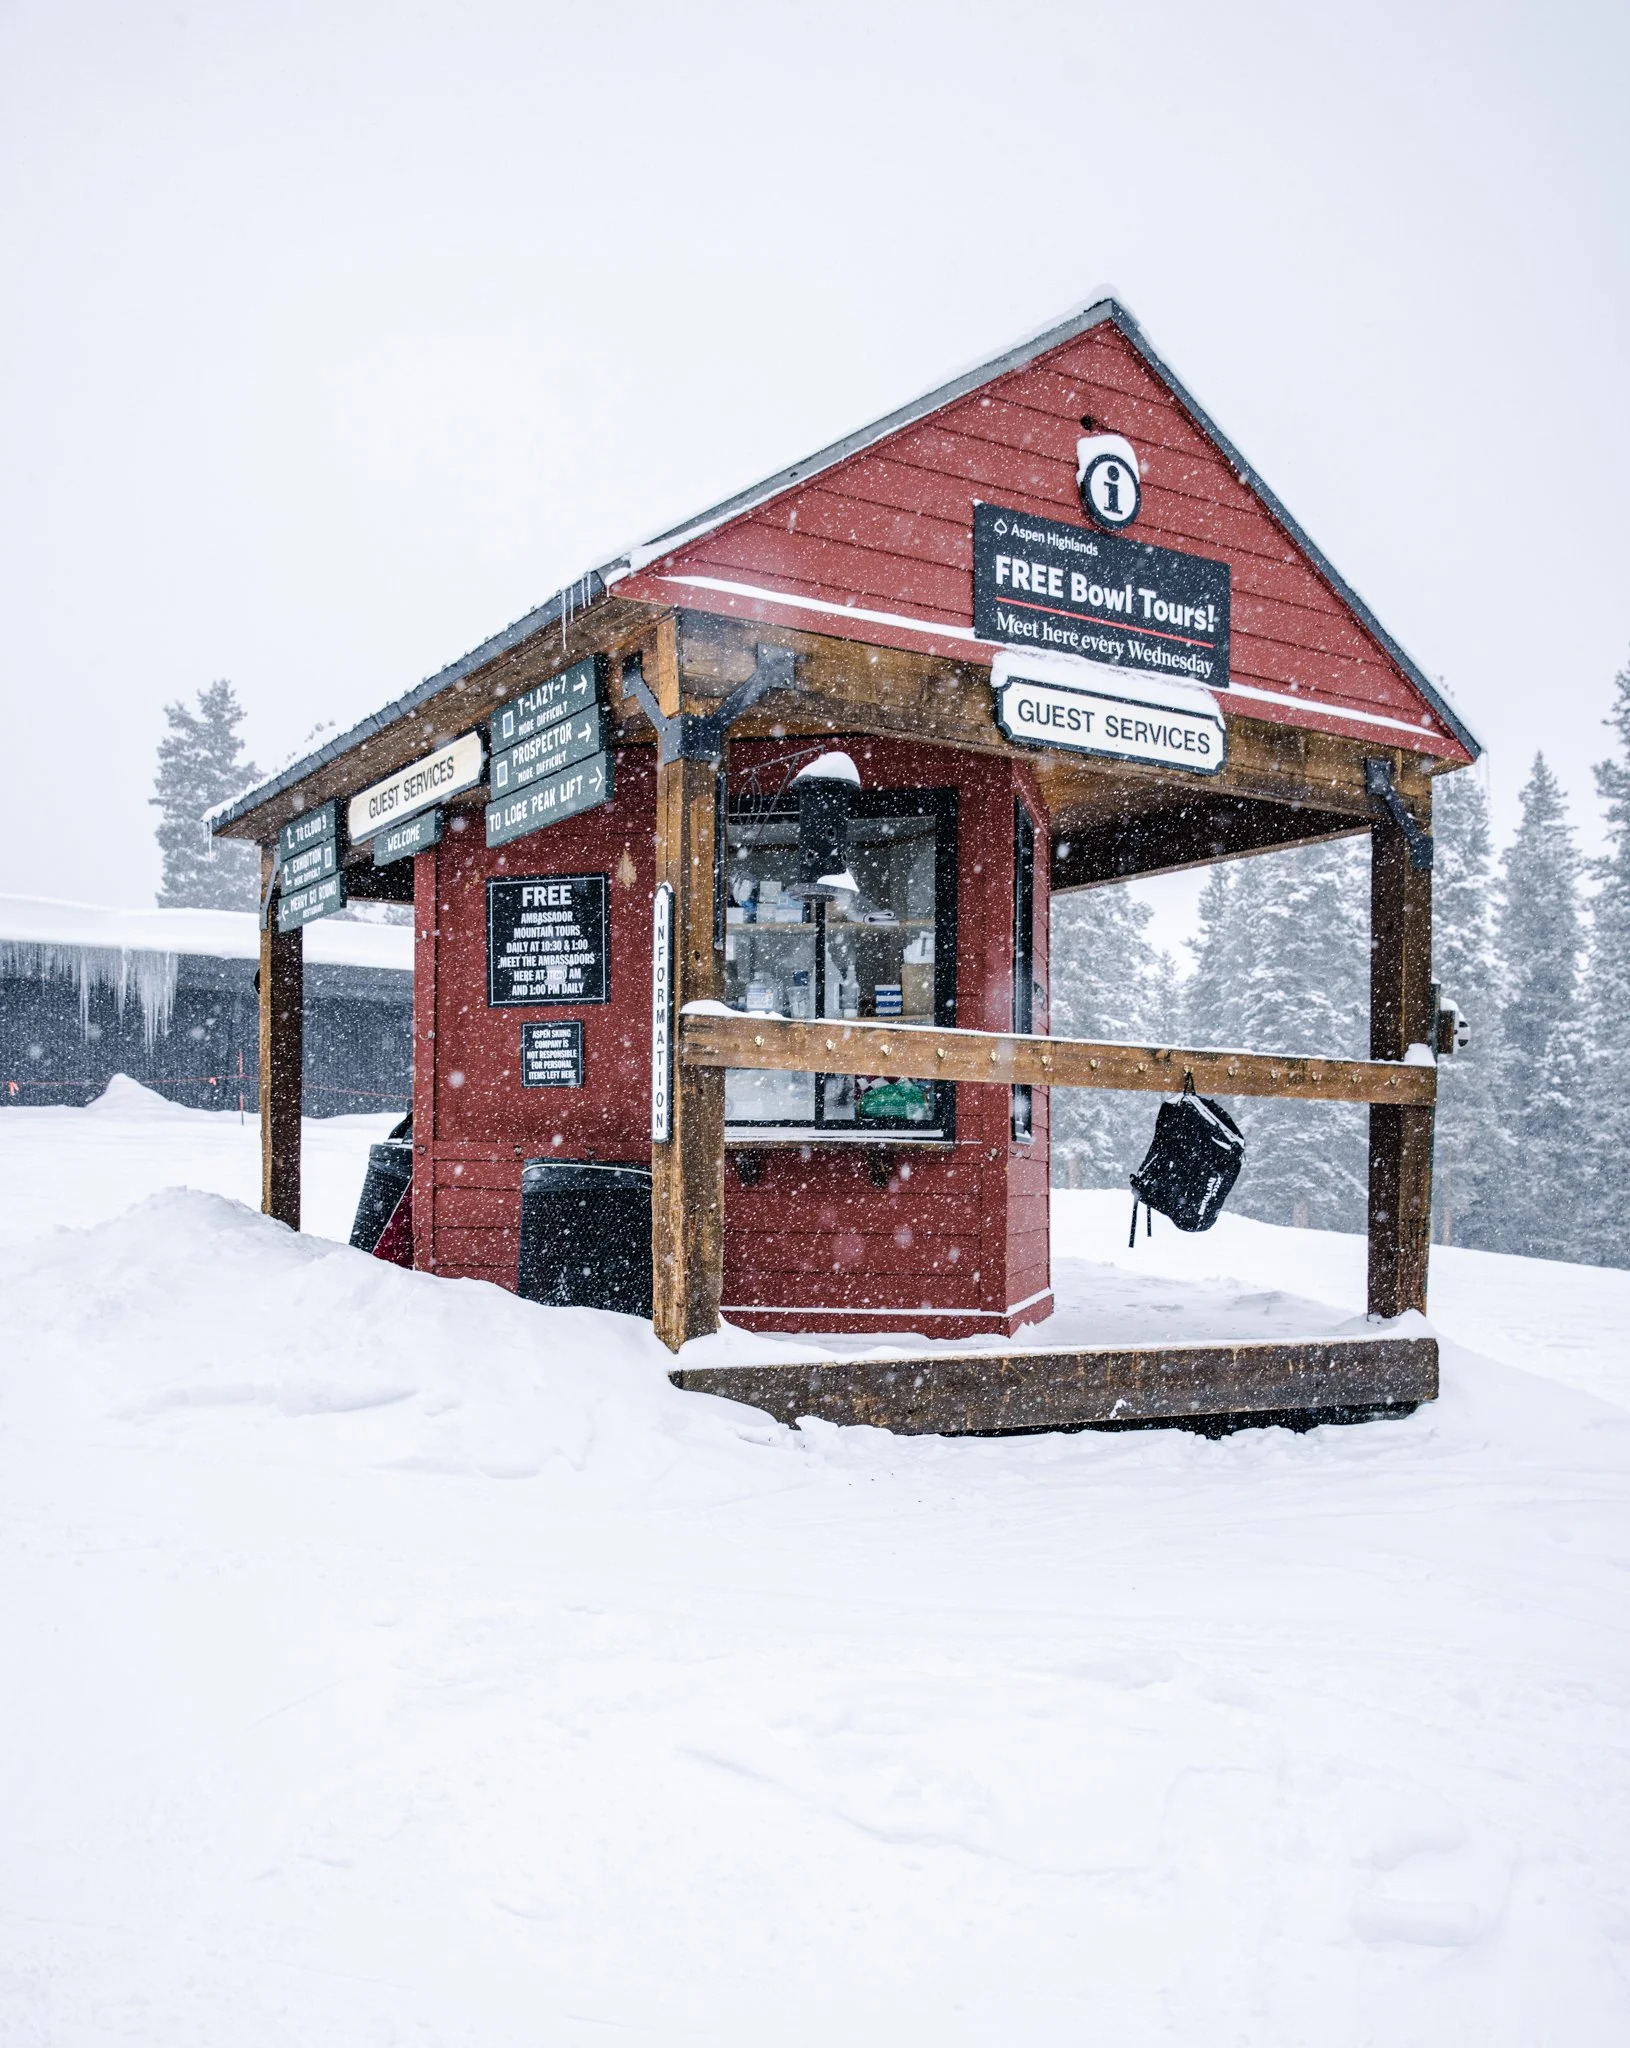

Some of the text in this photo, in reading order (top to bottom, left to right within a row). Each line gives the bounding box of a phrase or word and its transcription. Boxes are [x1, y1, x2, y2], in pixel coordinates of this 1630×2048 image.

[1011, 523, 1099, 557] Aspen Highlands
[995, 554, 1215, 633] FREE Bowl Tours!
[996, 608, 1214, 679] Meet here every Wednesday
[518, 674, 567, 716] T-LAZY-7
[519, 701, 567, 737] MORE DIFFICULT
[1018, 699, 1210, 755] GUEST SERVICES
[512, 722, 572, 767] PROSPECTOR
[518, 750, 567, 783] MORE DIFFICULT
[369, 756, 454, 819] GUEST SERVICES
[490, 775, 583, 832] TO LOGE PEAK LIFT
[296, 827, 304, 842] TO
[304, 817, 321, 839] CLOUD
[387, 824, 421, 852] WELCOME
[292, 848, 321, 873] EXHIBITION
[290, 880, 336, 912] MERRY GO ROUND
[522, 885, 572, 907] FREE
[521, 911, 573, 924] AMBASSADOR
[513, 925, 581, 938] MOUNTAIN TOURS
[506, 939, 588, 953] DAILY AT 10:30 & 1:00
[500, 953, 595, 968] MEET THE AMBASSADORS
[513, 970, 534, 982] HERE
[535, 970, 545, 980] AT
[568, 968, 581, 979] AM
[512, 982, 584, 996] AND 1:00 PM DAILY
[656, 905, 666, 1128] INFORMATION
[532, 1029, 571, 1038] ASPEN SKIING
[534, 1039, 569, 1049] COMPANY IS
[527, 1049, 577, 1059] NOT RESPONSIBLE
[531, 1060, 572, 1069] FOR PERSONAL
[529, 1070, 576, 1080] ITEMS LEFT HERE
